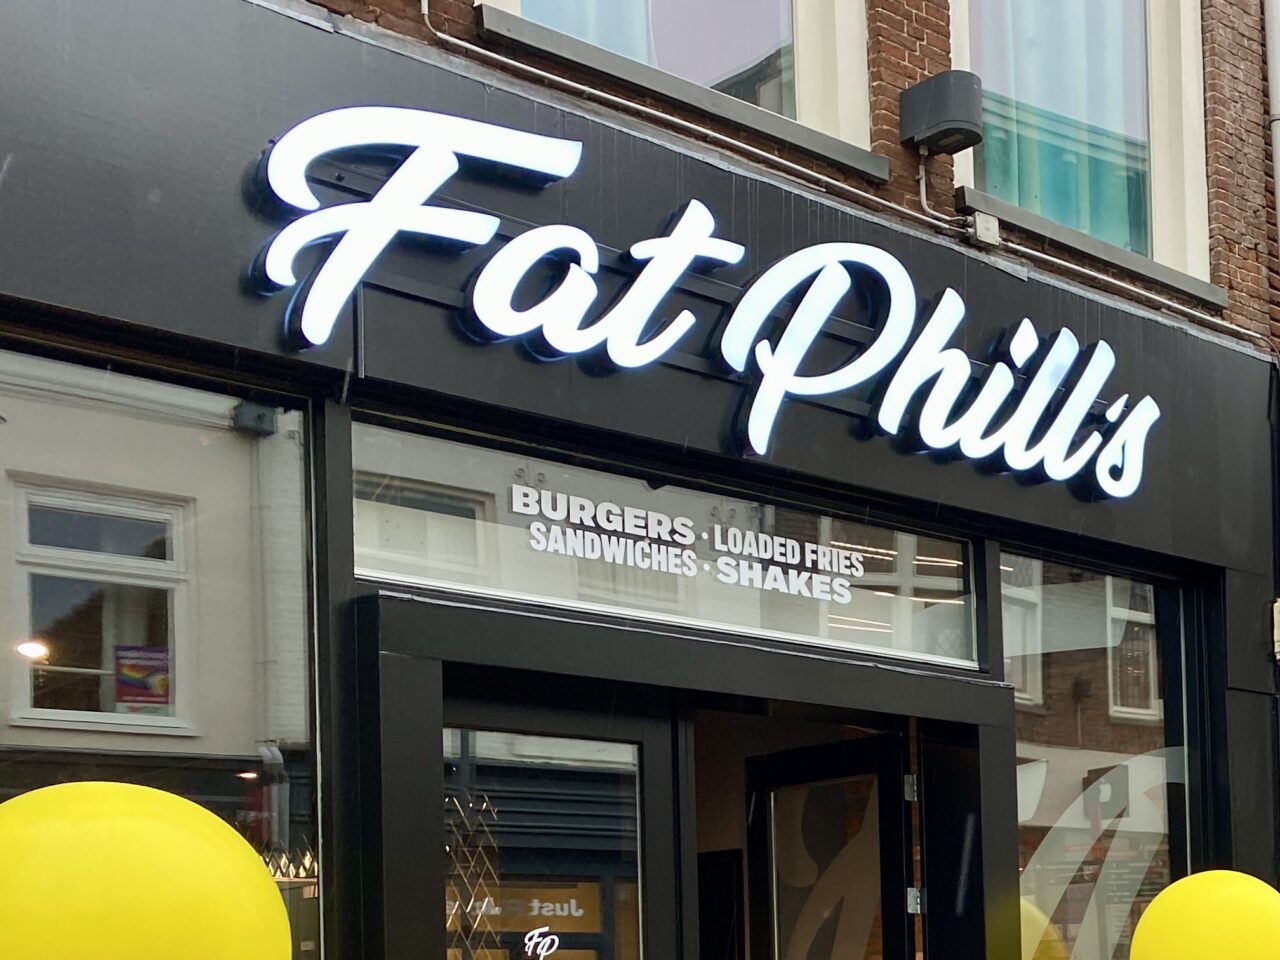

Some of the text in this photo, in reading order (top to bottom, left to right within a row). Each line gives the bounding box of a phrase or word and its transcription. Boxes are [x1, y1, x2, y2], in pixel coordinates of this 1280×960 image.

[265, 105, 1161, 499] Fat Phill's
[512, 483, 697, 546] BURGERS
[529, 521, 698, 577] SANDWICHES
[714, 524, 865, 578] LOADED FRIES
[716, 556, 852, 605] SHAKES
